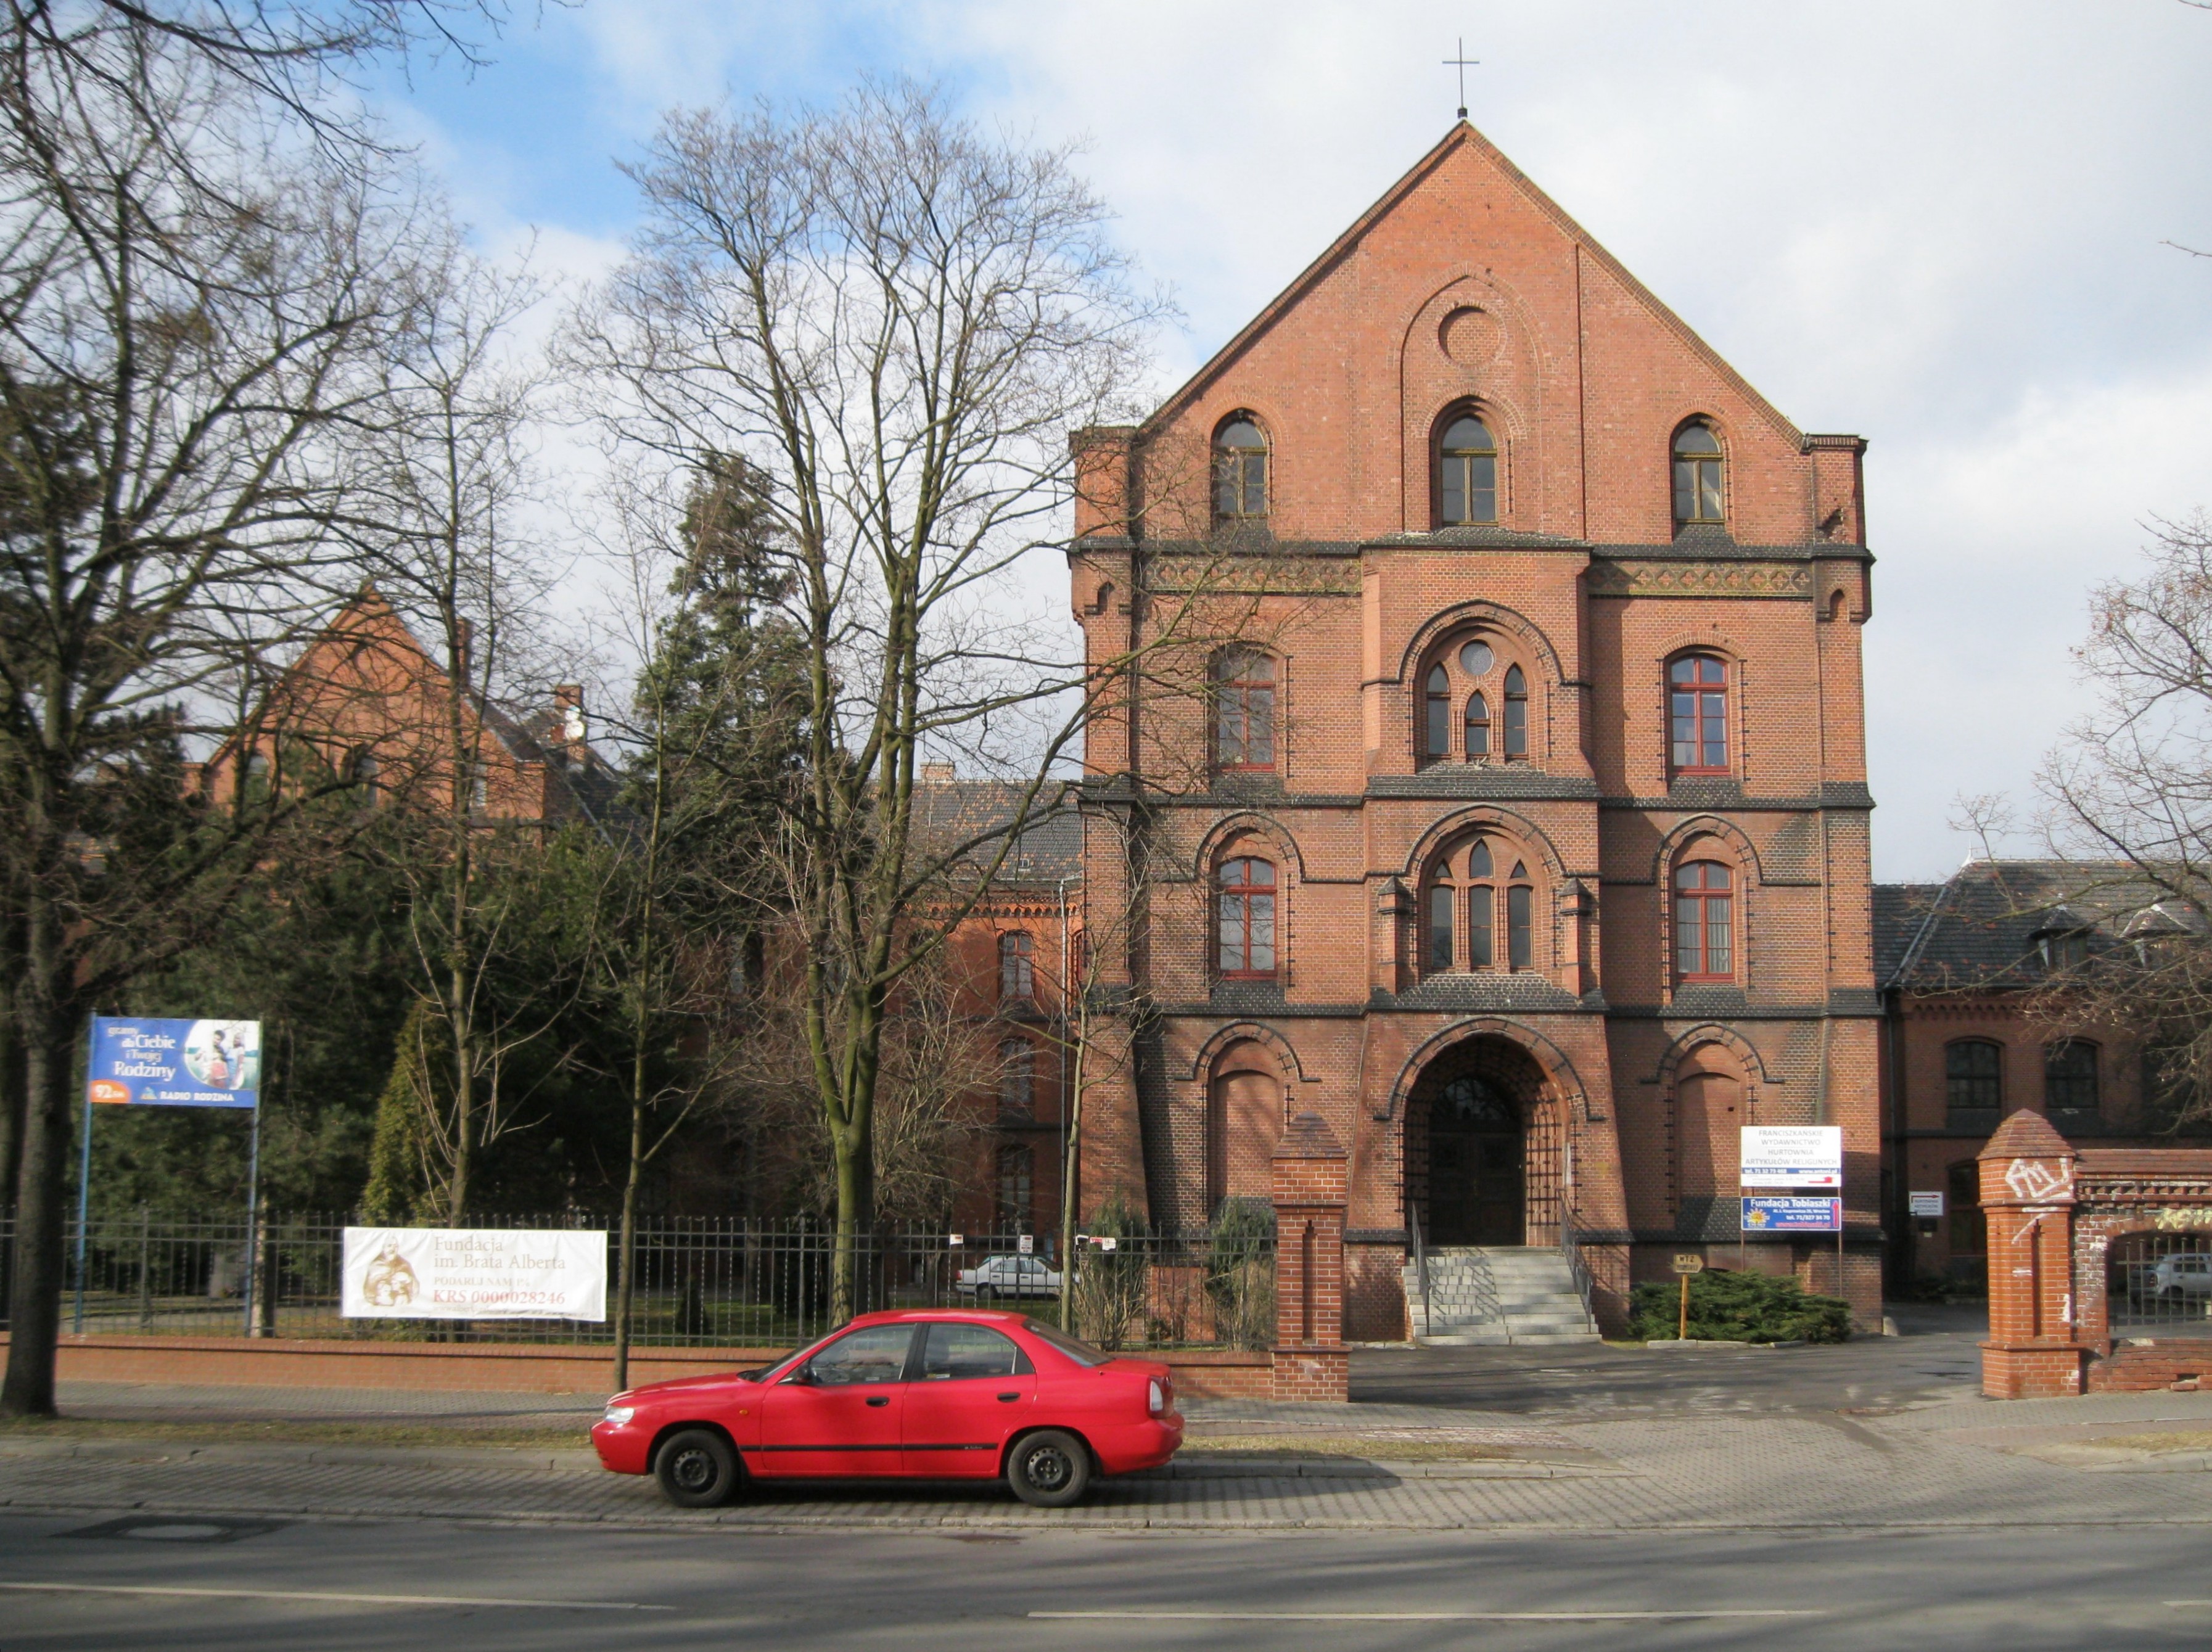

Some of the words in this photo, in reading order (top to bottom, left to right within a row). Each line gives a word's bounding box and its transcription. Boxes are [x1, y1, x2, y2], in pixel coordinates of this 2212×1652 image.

[136, 1034, 176, 1049] Ciebie
[131, 1049, 163, 1062] Twojej
[114, 1061, 176, 1082] Rodziny
[160, 1090, 191, 1101] RADIO
[193, 1091, 234, 1102] RODZINA
[1758, 1128, 1823, 1136] FRANCISZKAŃSKIE
[1745, 1157, 1791, 1165] ARTYKUŁÓW
[1750, 1199, 1790, 1208] Fundacja
[1791, 1199, 1830, 1207] Tobiaszki
[434, 1236, 503, 1255] Fundacja
[434, 1254, 458, 1268] im.
[463, 1254, 503, 1268] Brata
[508, 1254, 566, 1269] Alberta
[434, 1276, 484, 1286] PODARUJ
[487, 1277, 512, 1286] NAM
[433, 1289, 467, 1303] KRS
[471, 1290, 565, 1305] 0000028246
